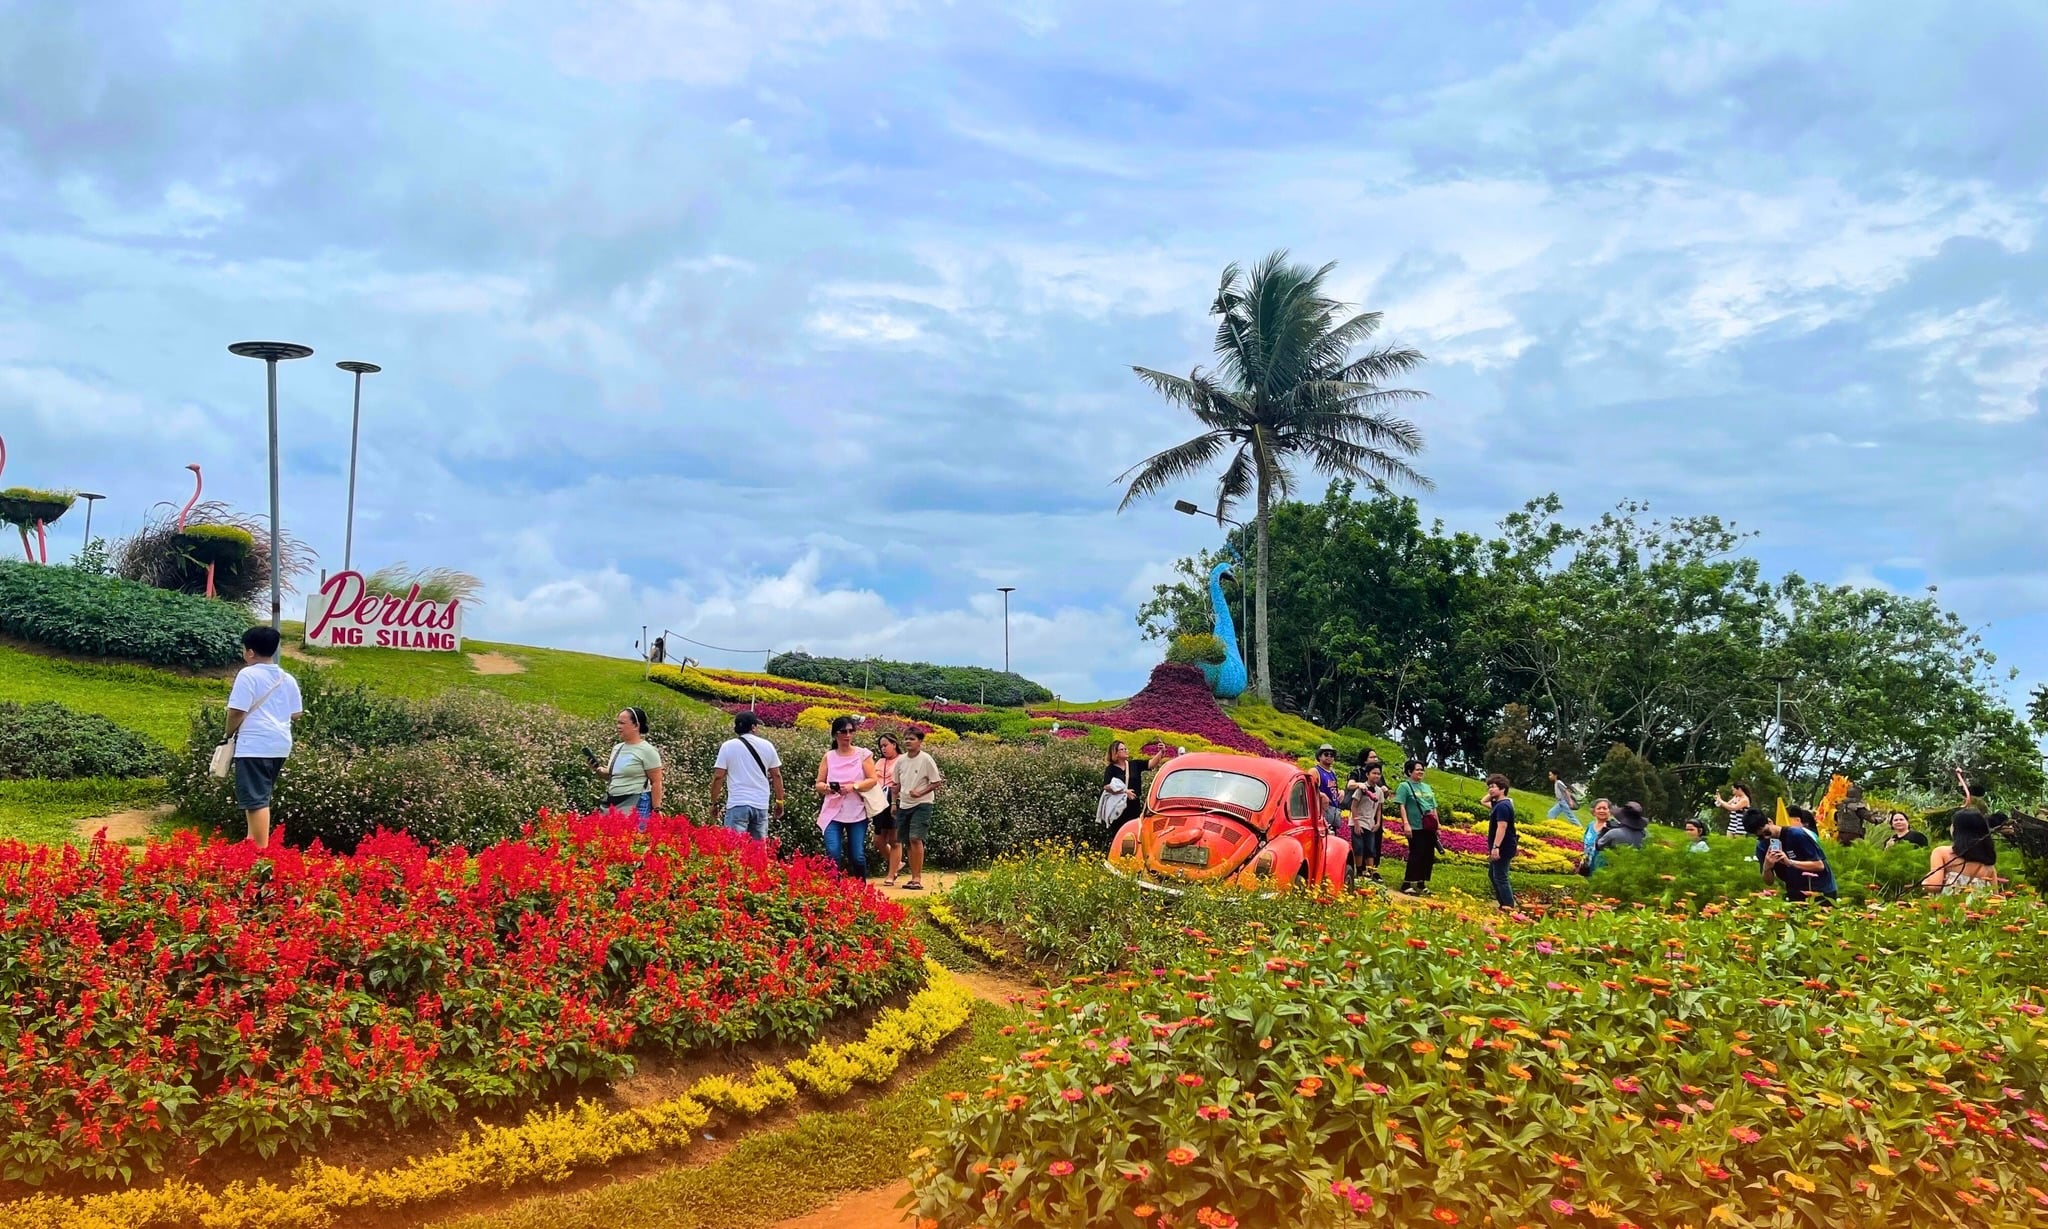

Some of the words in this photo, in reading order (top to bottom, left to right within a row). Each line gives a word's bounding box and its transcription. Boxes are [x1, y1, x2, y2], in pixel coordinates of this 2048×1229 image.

[309, 570, 460, 640] Perlas
[331, 627, 363, 645] NG
[376, 629, 455, 650] SILANG
